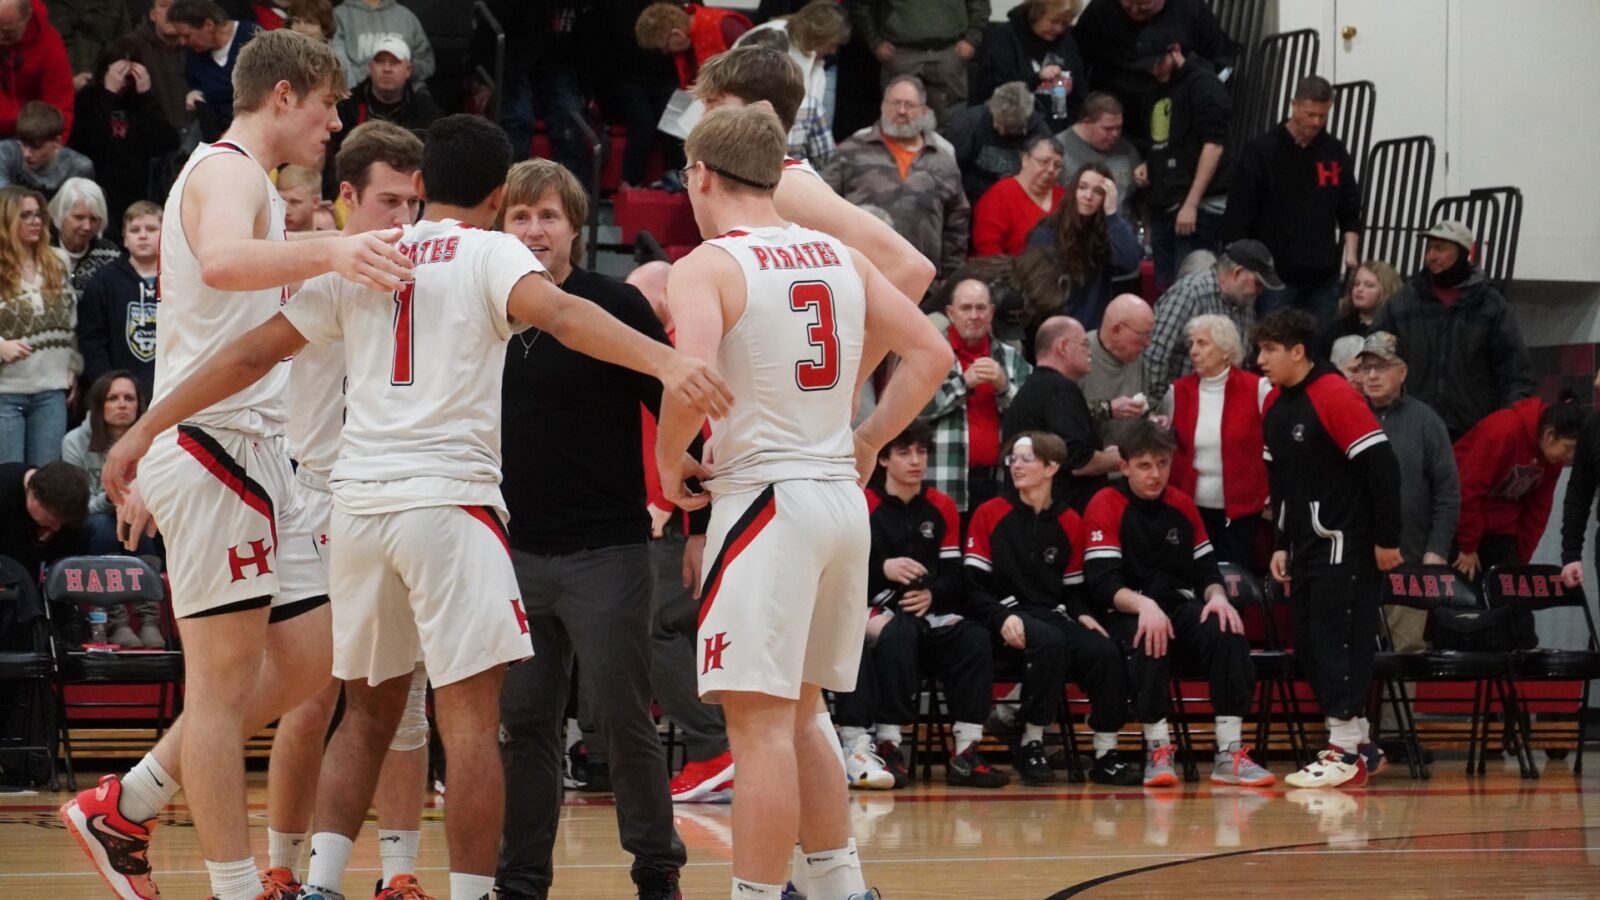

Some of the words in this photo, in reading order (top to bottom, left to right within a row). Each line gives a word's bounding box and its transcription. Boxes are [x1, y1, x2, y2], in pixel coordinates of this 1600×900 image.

[749, 241, 842, 270] PIRATES
[391, 279, 415, 386] 1
[789, 280, 840, 392] 3
[64, 568, 144, 593] HART
[1389, 573, 1455, 598] HART
[1499, 573, 1566, 597] HART
